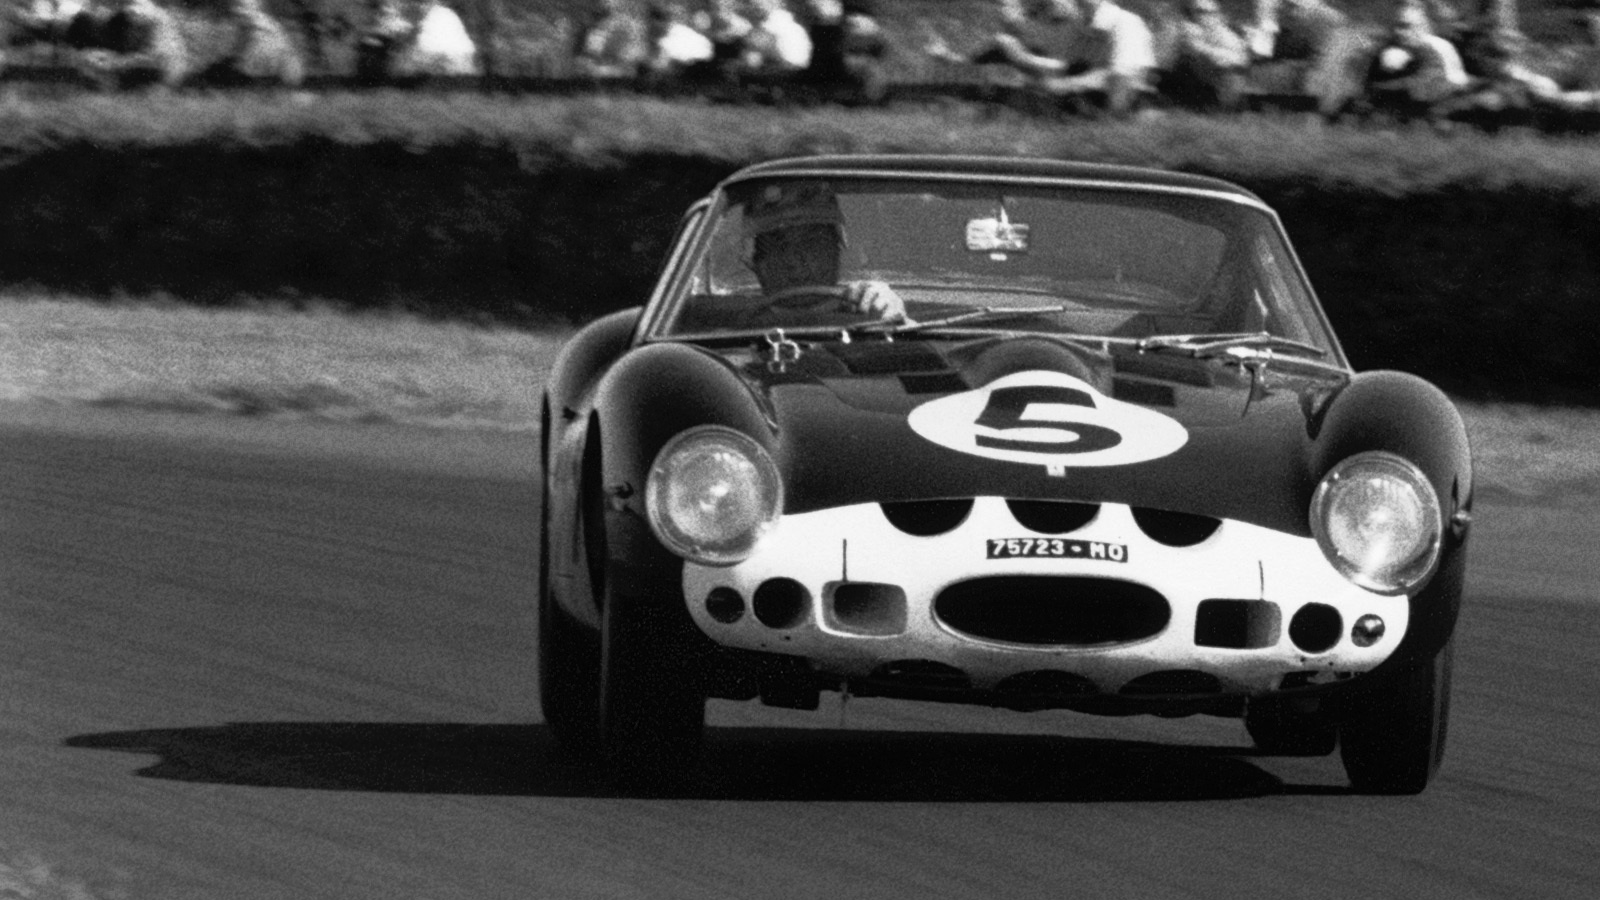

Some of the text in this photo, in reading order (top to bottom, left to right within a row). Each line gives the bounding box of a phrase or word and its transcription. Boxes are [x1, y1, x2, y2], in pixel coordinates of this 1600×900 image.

[974, 385, 1122, 454] 5
[993, 539, 1124, 561] 75723 MO
